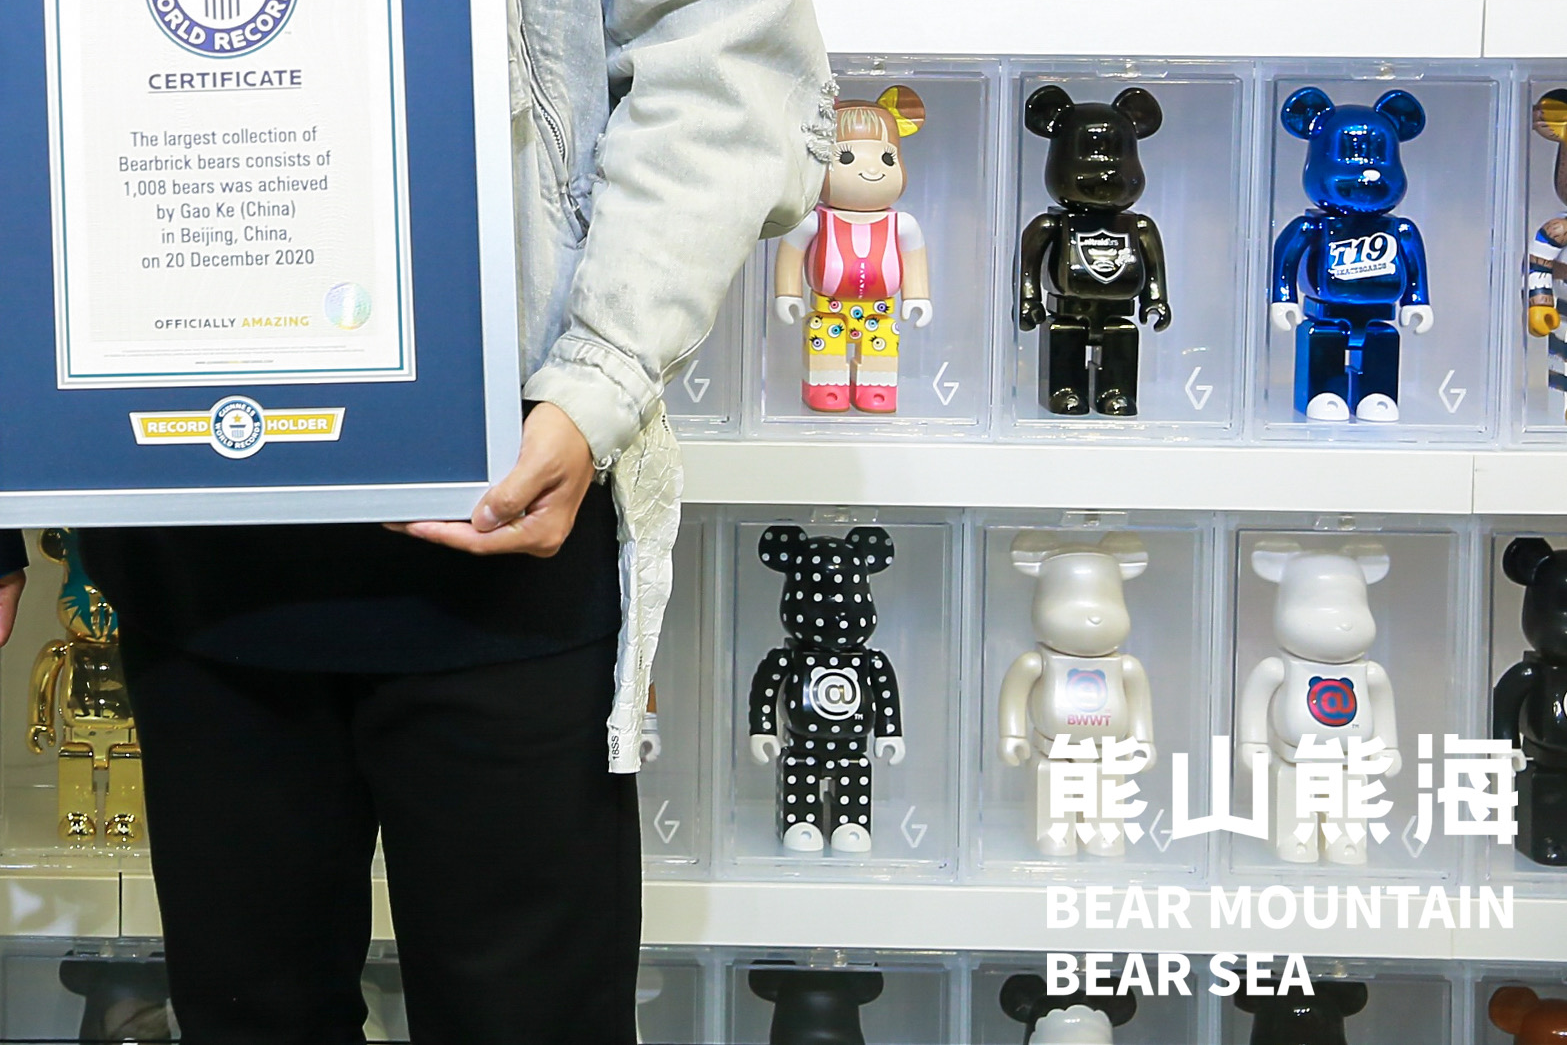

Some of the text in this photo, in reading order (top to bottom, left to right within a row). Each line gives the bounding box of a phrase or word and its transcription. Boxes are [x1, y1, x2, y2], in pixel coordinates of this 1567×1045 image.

[149, 69, 302, 90] CERTIFICATE
[131, 126, 318, 149] The largest collection of
[119, 150, 331, 172] Bearbrick bears consists of
[124, 176, 328, 197] 1,008 bears was achieved
[157, 200, 296, 223] by Gao Ke (China)
[162, 225, 292, 247] in Beijing, China,
[142, 249, 314, 269] on 20 December 2020
[154, 316, 310, 329] OFFICIALLY AMAZING
[148, 418, 327, 433] RECORD HOLDER
[1067, 714, 1112, 726] BWWT
